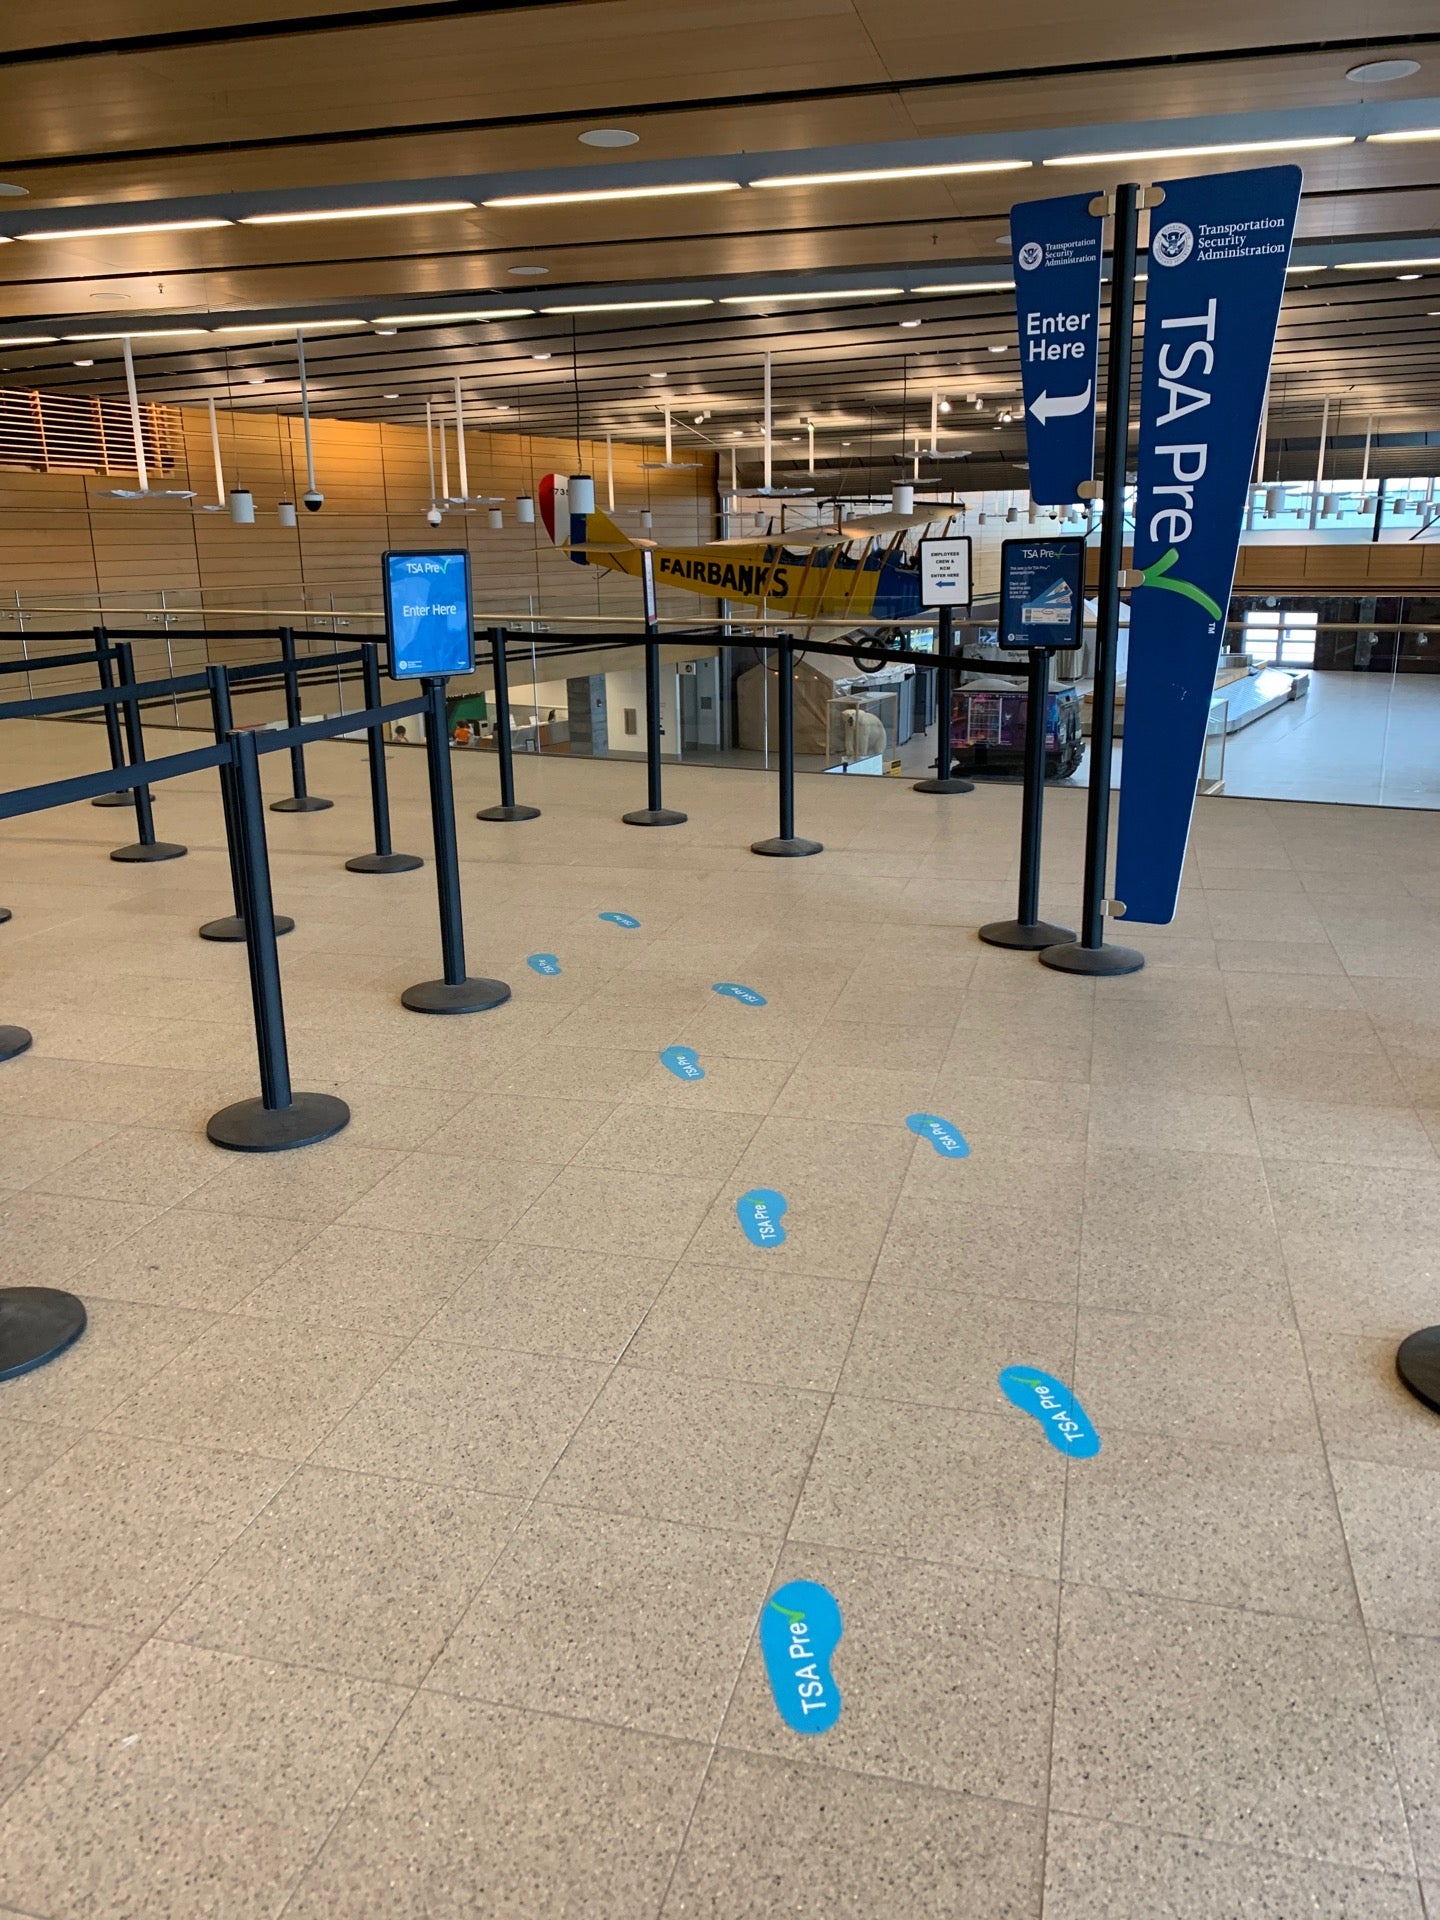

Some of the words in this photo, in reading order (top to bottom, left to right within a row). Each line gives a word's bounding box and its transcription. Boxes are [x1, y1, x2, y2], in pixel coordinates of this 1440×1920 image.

[1198, 217, 1285, 236] Transportation
[1045, 238, 1096, 251] Transportation
[1198, 234, 1247, 249] Security
[1045, 250, 1074, 259] Security
[1045, 255, 1097, 268] Administration
[1197, 243, 1285, 261] Administration
[1026, 311, 1091, 336] Enter
[1028, 339, 1086, 363] Here
[1156, 298, 1217, 428] TSA
[1150, 443, 1208, 544] Pre
[1022, 549, 1038, 559] TSA
[406, 563, 424, 574] TSA
[660, 557, 789, 599] FAIRBANKS
[403, 605, 430, 617] Enter
[432, 604, 457, 616] Here
[939, 1135, 960, 1151] TSA
[757, 1219, 777, 1240] TSA
[1034, 1385, 1062, 1410] Pre
[1051, 1410, 1084, 1442] TSA
[788, 1621, 815, 1659] Pre
[794, 1663, 827, 1715] TSA
